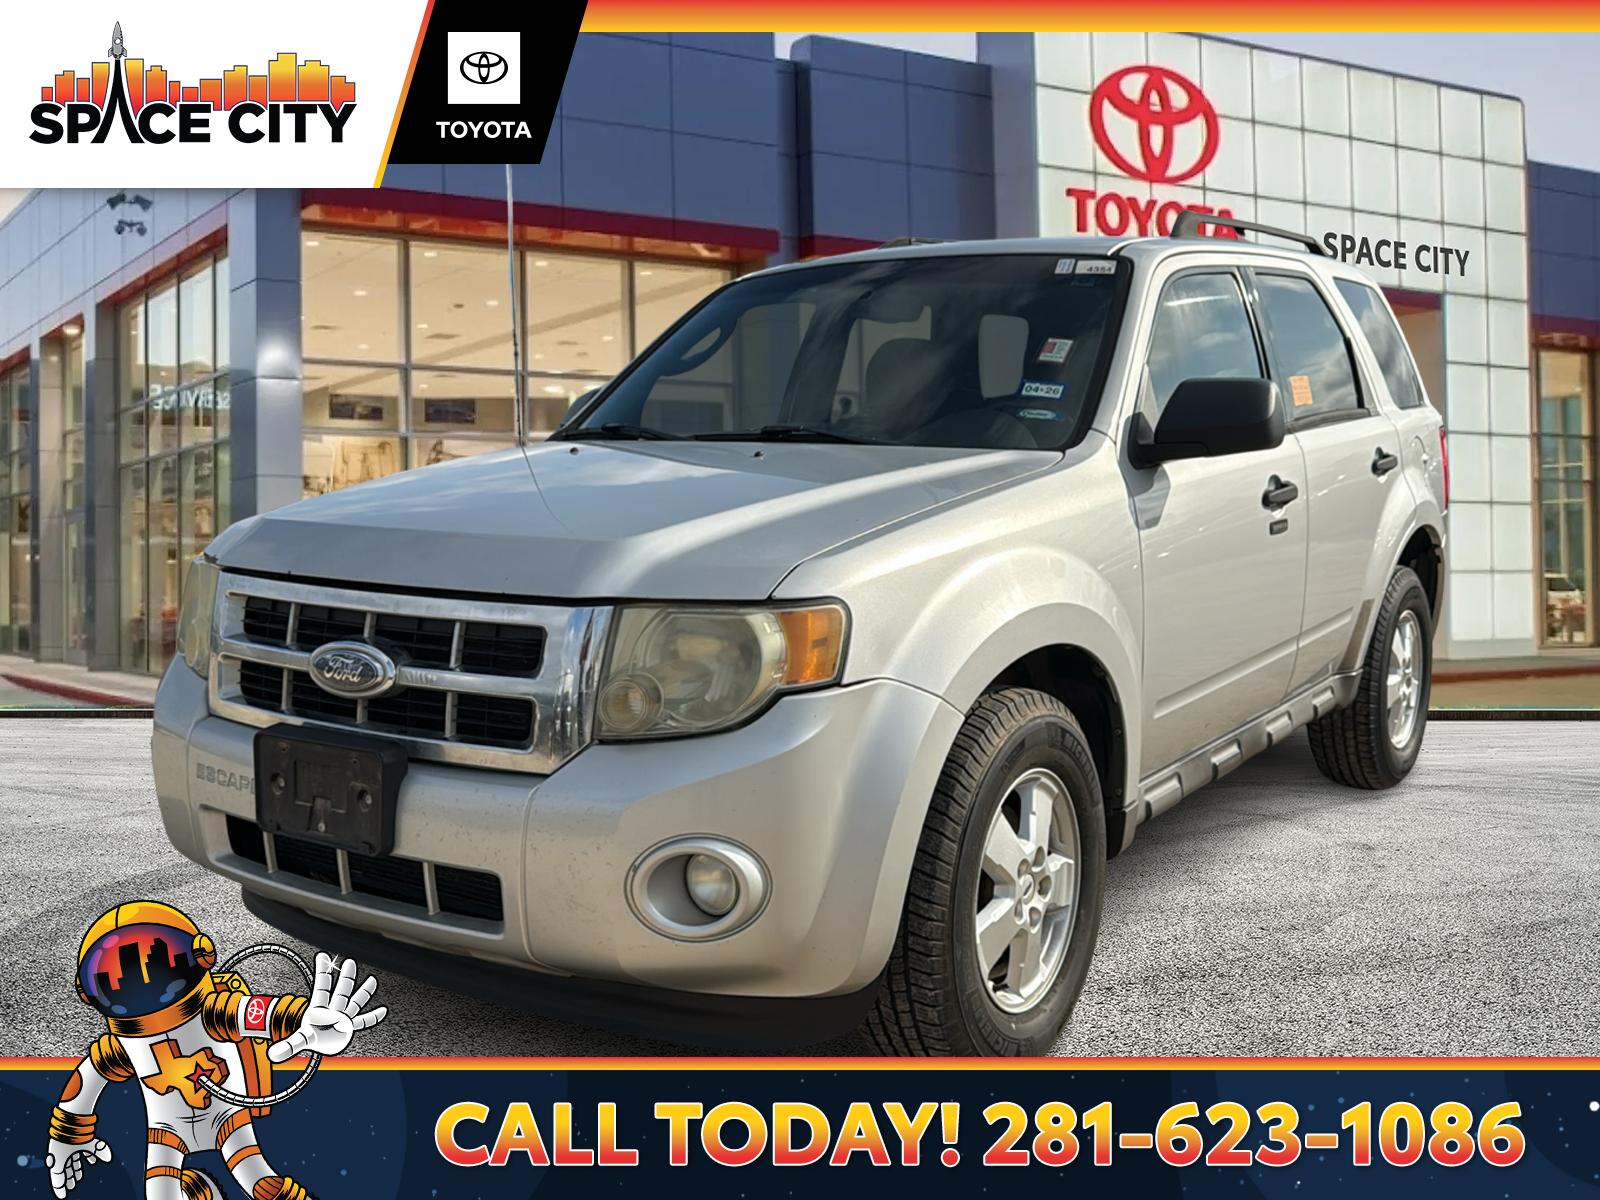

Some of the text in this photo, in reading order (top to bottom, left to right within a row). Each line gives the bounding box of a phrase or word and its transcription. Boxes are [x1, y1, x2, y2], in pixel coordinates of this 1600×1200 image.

[1323, 232, 1470, 277] SPACE CITY
[324, 656, 363, 683] Ford
